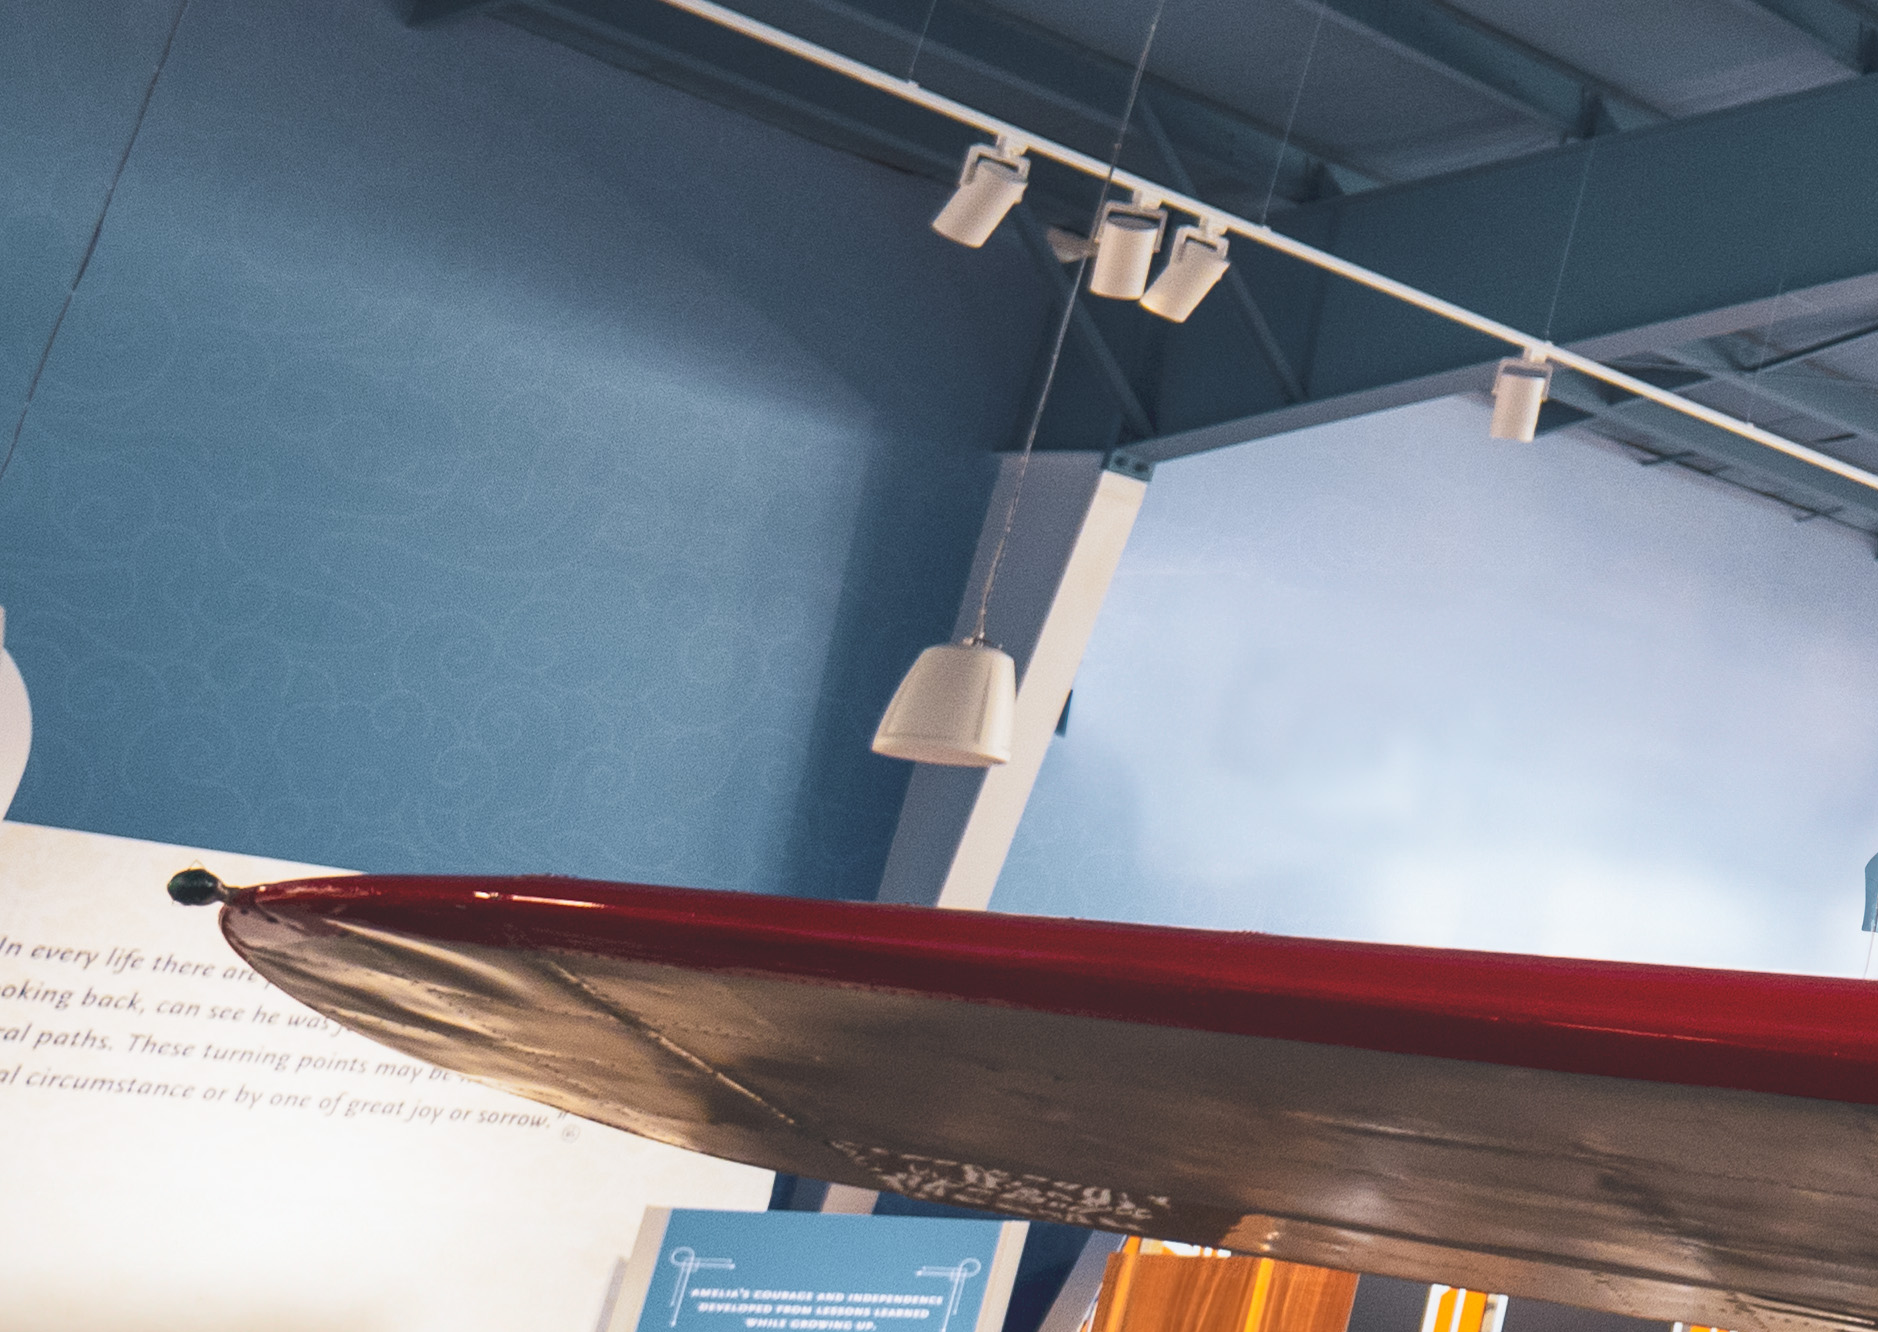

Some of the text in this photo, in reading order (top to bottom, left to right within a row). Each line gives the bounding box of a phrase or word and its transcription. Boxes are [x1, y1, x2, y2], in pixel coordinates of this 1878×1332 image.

[0, 936, 22, 957] In
[30, 945, 100, 970] every
[105, 947, 145, 975] life
[152, 954, 216, 979] there
[80, 987, 146, 1015] back,
[156, 1000, 201, 1017] can
[207, 1006, 245, 1022] see
[251, 1004, 281, 1025] he
[287, 1014, 329, 1031] was
[32, 1028, 114, 1051] paths.
[127, 1033, 197, 1059] These
[203, 1043, 290, 1071] turning
[296, 1052, 368, 1074] points
[374, 1062, 423, 1083] may
[25, 1066, 195, 1100] circumstance
[202, 1088, 228, 1102] or
[234, 1083, 263, 1109] by
[269, 1092, 312, 1109] one
[318, 1091, 347, 1117] of
[345, 1097, 405, 1118] great
[406, 1100, 444, 1125] joy
[449, 1107, 472, 1121] or
[690, 1287, 750, 1300] AMELIA'S
[816, 1291, 845, 1303] AND
[848, 1293, 943, 1306] INDEPENDENCE
[698, 1303, 930, 1319] DEVELOPED FROM LESSONS LEARNED
[745, 1317, 786, 1329] WHILE
[789, 1318, 852, 1331] GROWING
